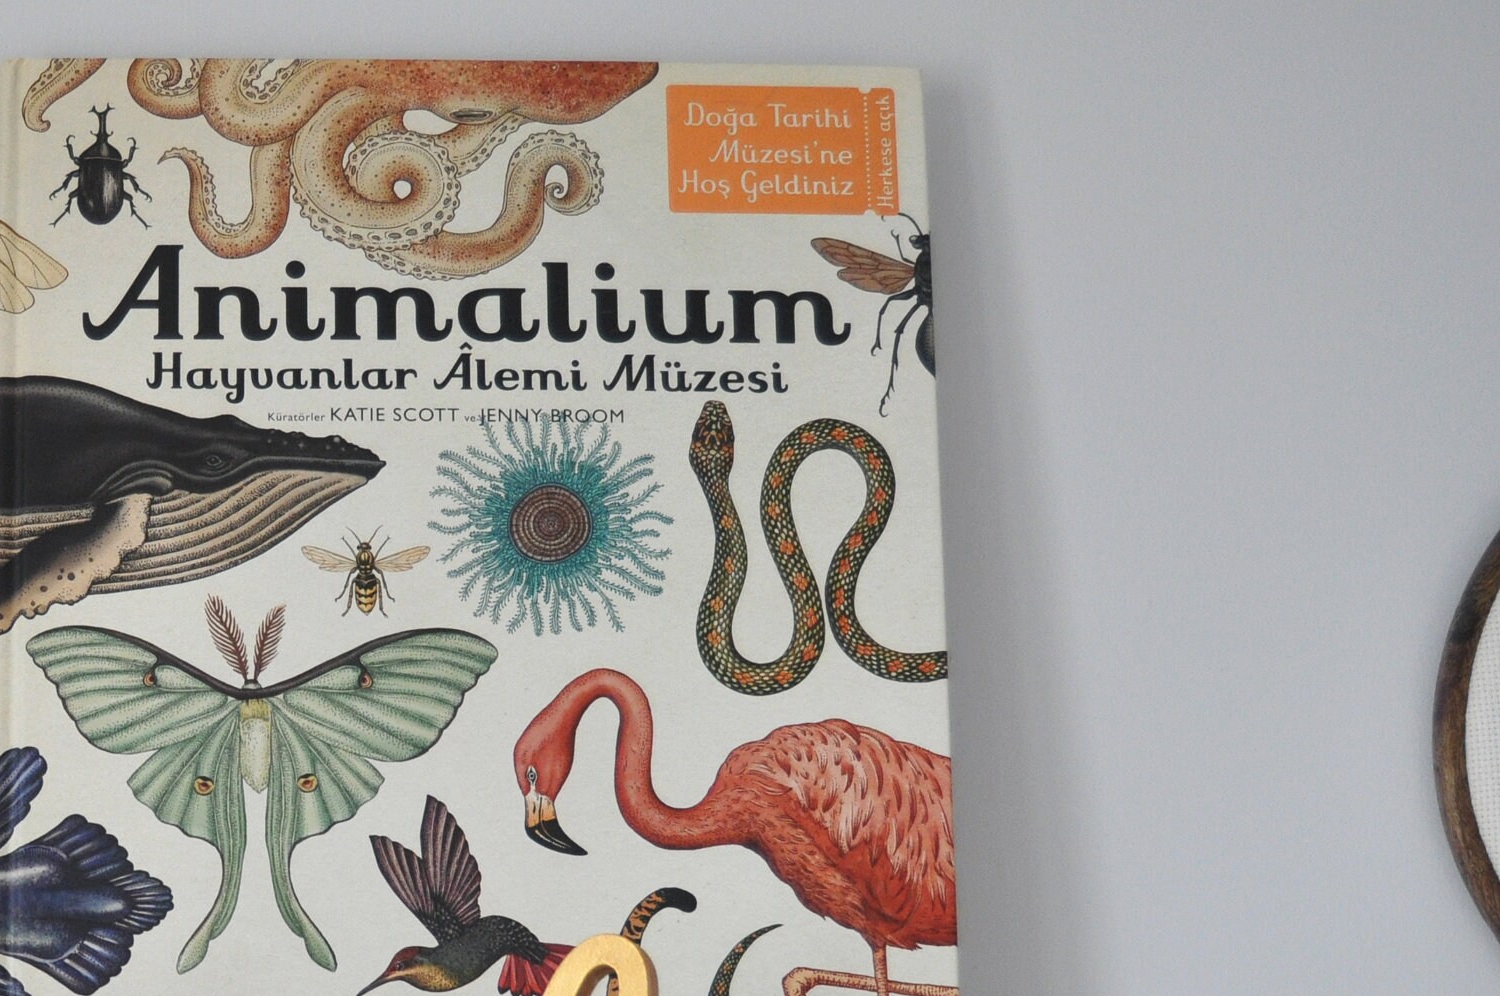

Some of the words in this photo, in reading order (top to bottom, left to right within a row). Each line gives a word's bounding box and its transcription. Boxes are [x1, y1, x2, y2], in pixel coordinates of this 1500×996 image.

[684, 102, 758, 135] Doğa
[767, 103, 852, 129] Tarihi
[875, 95, 894, 132] açık
[709, 139, 853, 165] Müzesi'ne
[678, 169, 731, 199] Hoş
[740, 170, 854, 203] Geldiniz
[876, 137, 894, 209] Herkese
[82, 244, 851, 346] Animalium
[146, 352, 418, 403] Hayvanlar
[433, 341, 588, 392] Âlemi
[602, 354, 789, 394] Müzesi
[267, 411, 326, 423] Küratörler
[330, 407, 386, 423] KATIE
[392, 407, 460, 423] SCOTT
[479, 407, 543, 426] JENNY
[550, 408, 625, 424] BROOM
